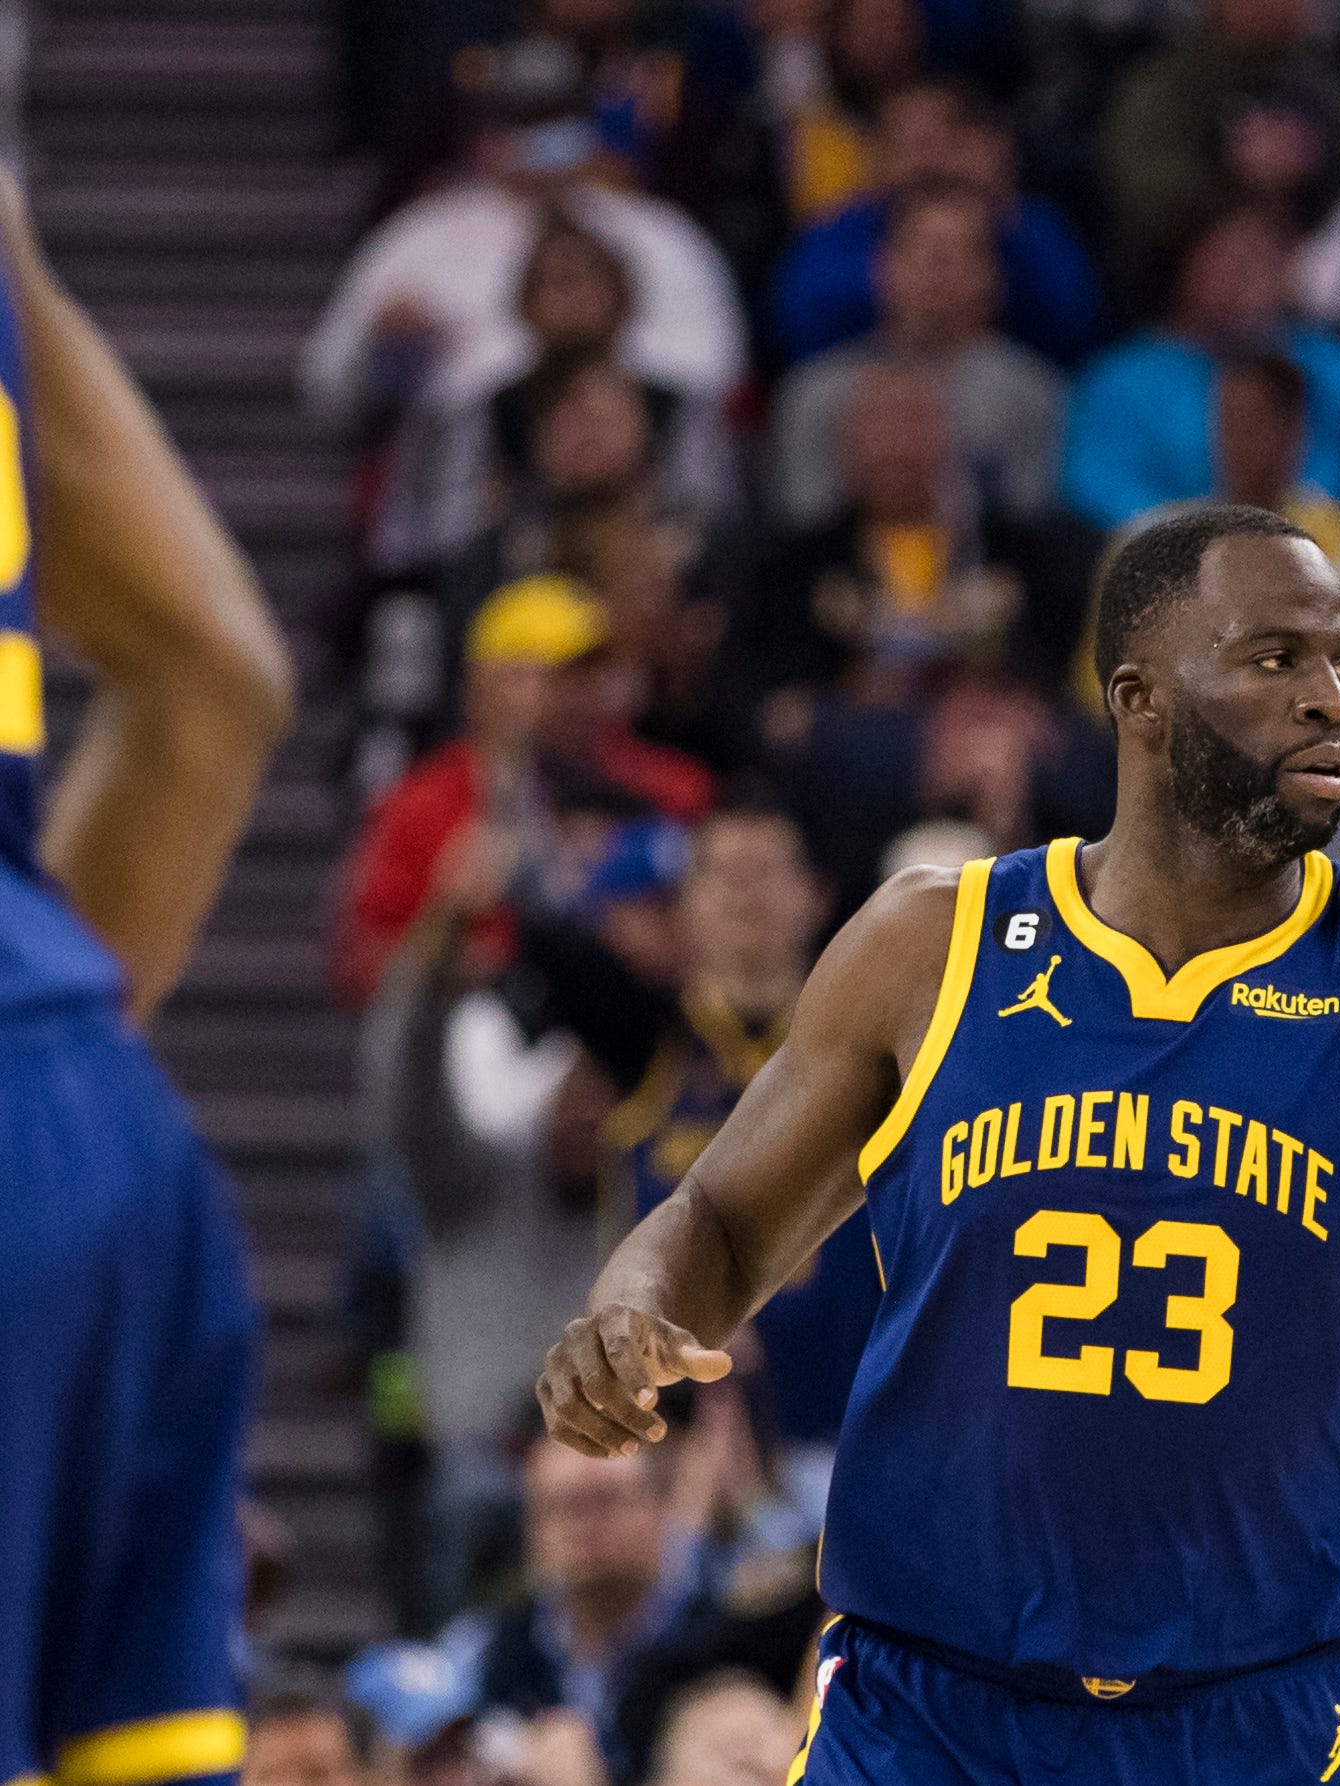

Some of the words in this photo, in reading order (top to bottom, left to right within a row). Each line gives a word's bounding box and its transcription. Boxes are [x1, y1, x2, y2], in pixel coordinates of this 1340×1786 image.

[1005, 913, 1040, 950] 6
[1231, 983, 1340, 1019] Rakuten
[941, 1091, 1149, 1206] GOLDEN
[1167, 1099, 1334, 1242] STATE
[1007, 1209, 1240, 1404] 23
